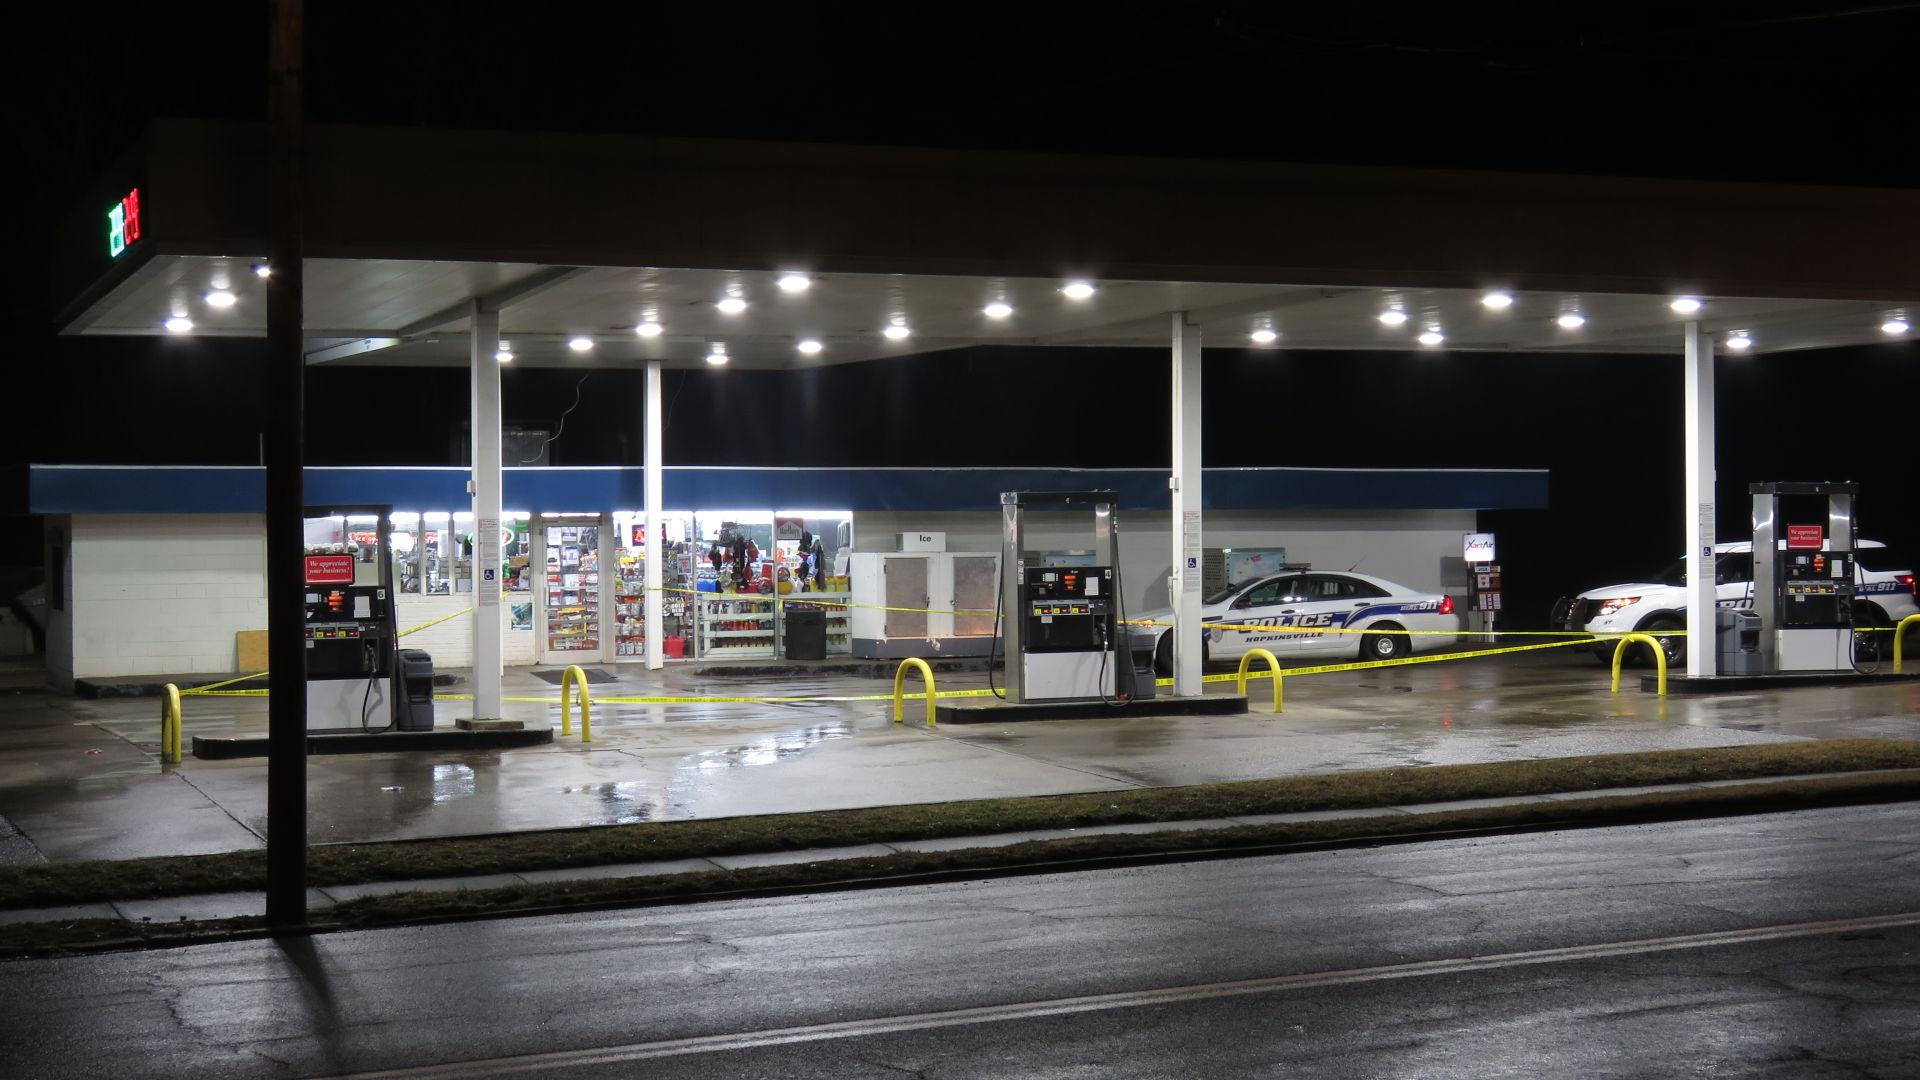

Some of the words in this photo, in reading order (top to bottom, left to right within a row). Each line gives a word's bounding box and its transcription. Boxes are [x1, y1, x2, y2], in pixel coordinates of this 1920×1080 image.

[920, 534, 931, 542] Ice
[1877, 582, 1896, 592] 911
[378, 590, 384, 599] 6
[1419, 601, 1437, 610] 911
[1239, 614, 1333, 632] POLICE
[1245, 632, 1324, 643] HOPKINSVILLE
